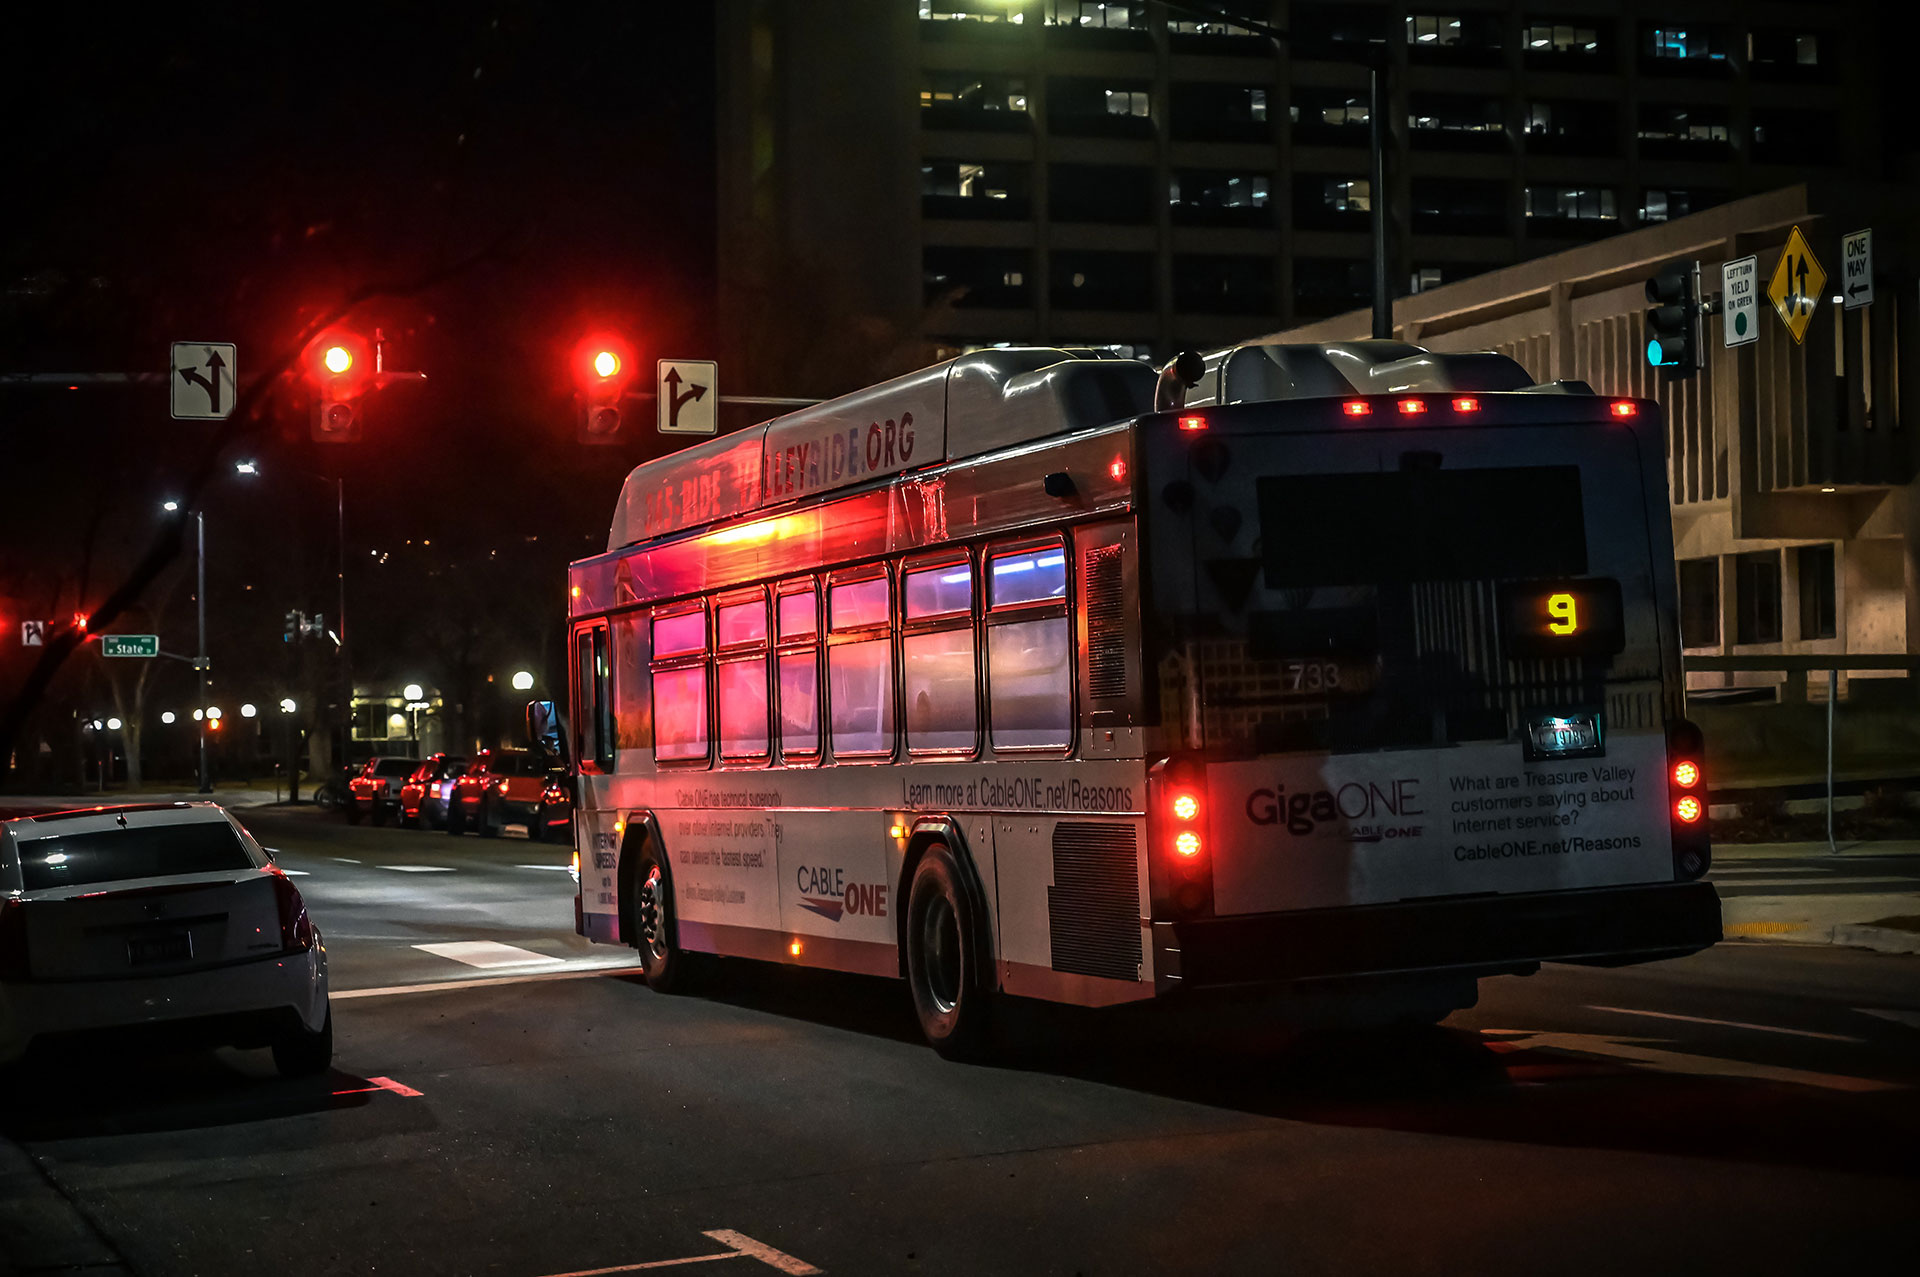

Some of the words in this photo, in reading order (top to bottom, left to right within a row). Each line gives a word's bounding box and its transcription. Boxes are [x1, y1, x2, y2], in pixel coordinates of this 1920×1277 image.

[1847, 238, 1866, 258] ONE
[1726, 266, 1738, 280] LEFT
[1738, 263, 1753, 276] TURN
[1847, 258, 1867, 277] WAY
[1731, 279, 1749, 296] YIELD
[1728, 299, 1736, 310] ON
[1736, 296, 1753, 309] GREEN
[1548, 593, 1577, 635] 9
[116, 644, 144, 655] State
[1289, 663, 1340, 690] 733
[1551, 729, 1587, 746] 19786
[1450, 775, 1491, 792] What
[1495, 777, 1520, 789] are
[1524, 770, 1588, 788] Treasure
[1592, 766, 1636, 784] Valley
[902, 777, 933, 806] Learn
[935, 783, 963, 806] more
[966, 779, 978, 807] at
[980, 776, 1133, 811] CableONE.net/Reasons
[1451, 794, 1533, 813] customers
[1537, 790, 1587, 810] saying
[1591, 787, 1635, 803] about
[1384, 826, 1424, 839] ONE
[1452, 816, 1512, 834] Internet
[1516, 809, 1580, 831] service?
[1453, 836, 1641, 862] CableONE.net/Reasons
[797, 865, 845, 897] CABLE
[844, 883, 887, 918] ONE
